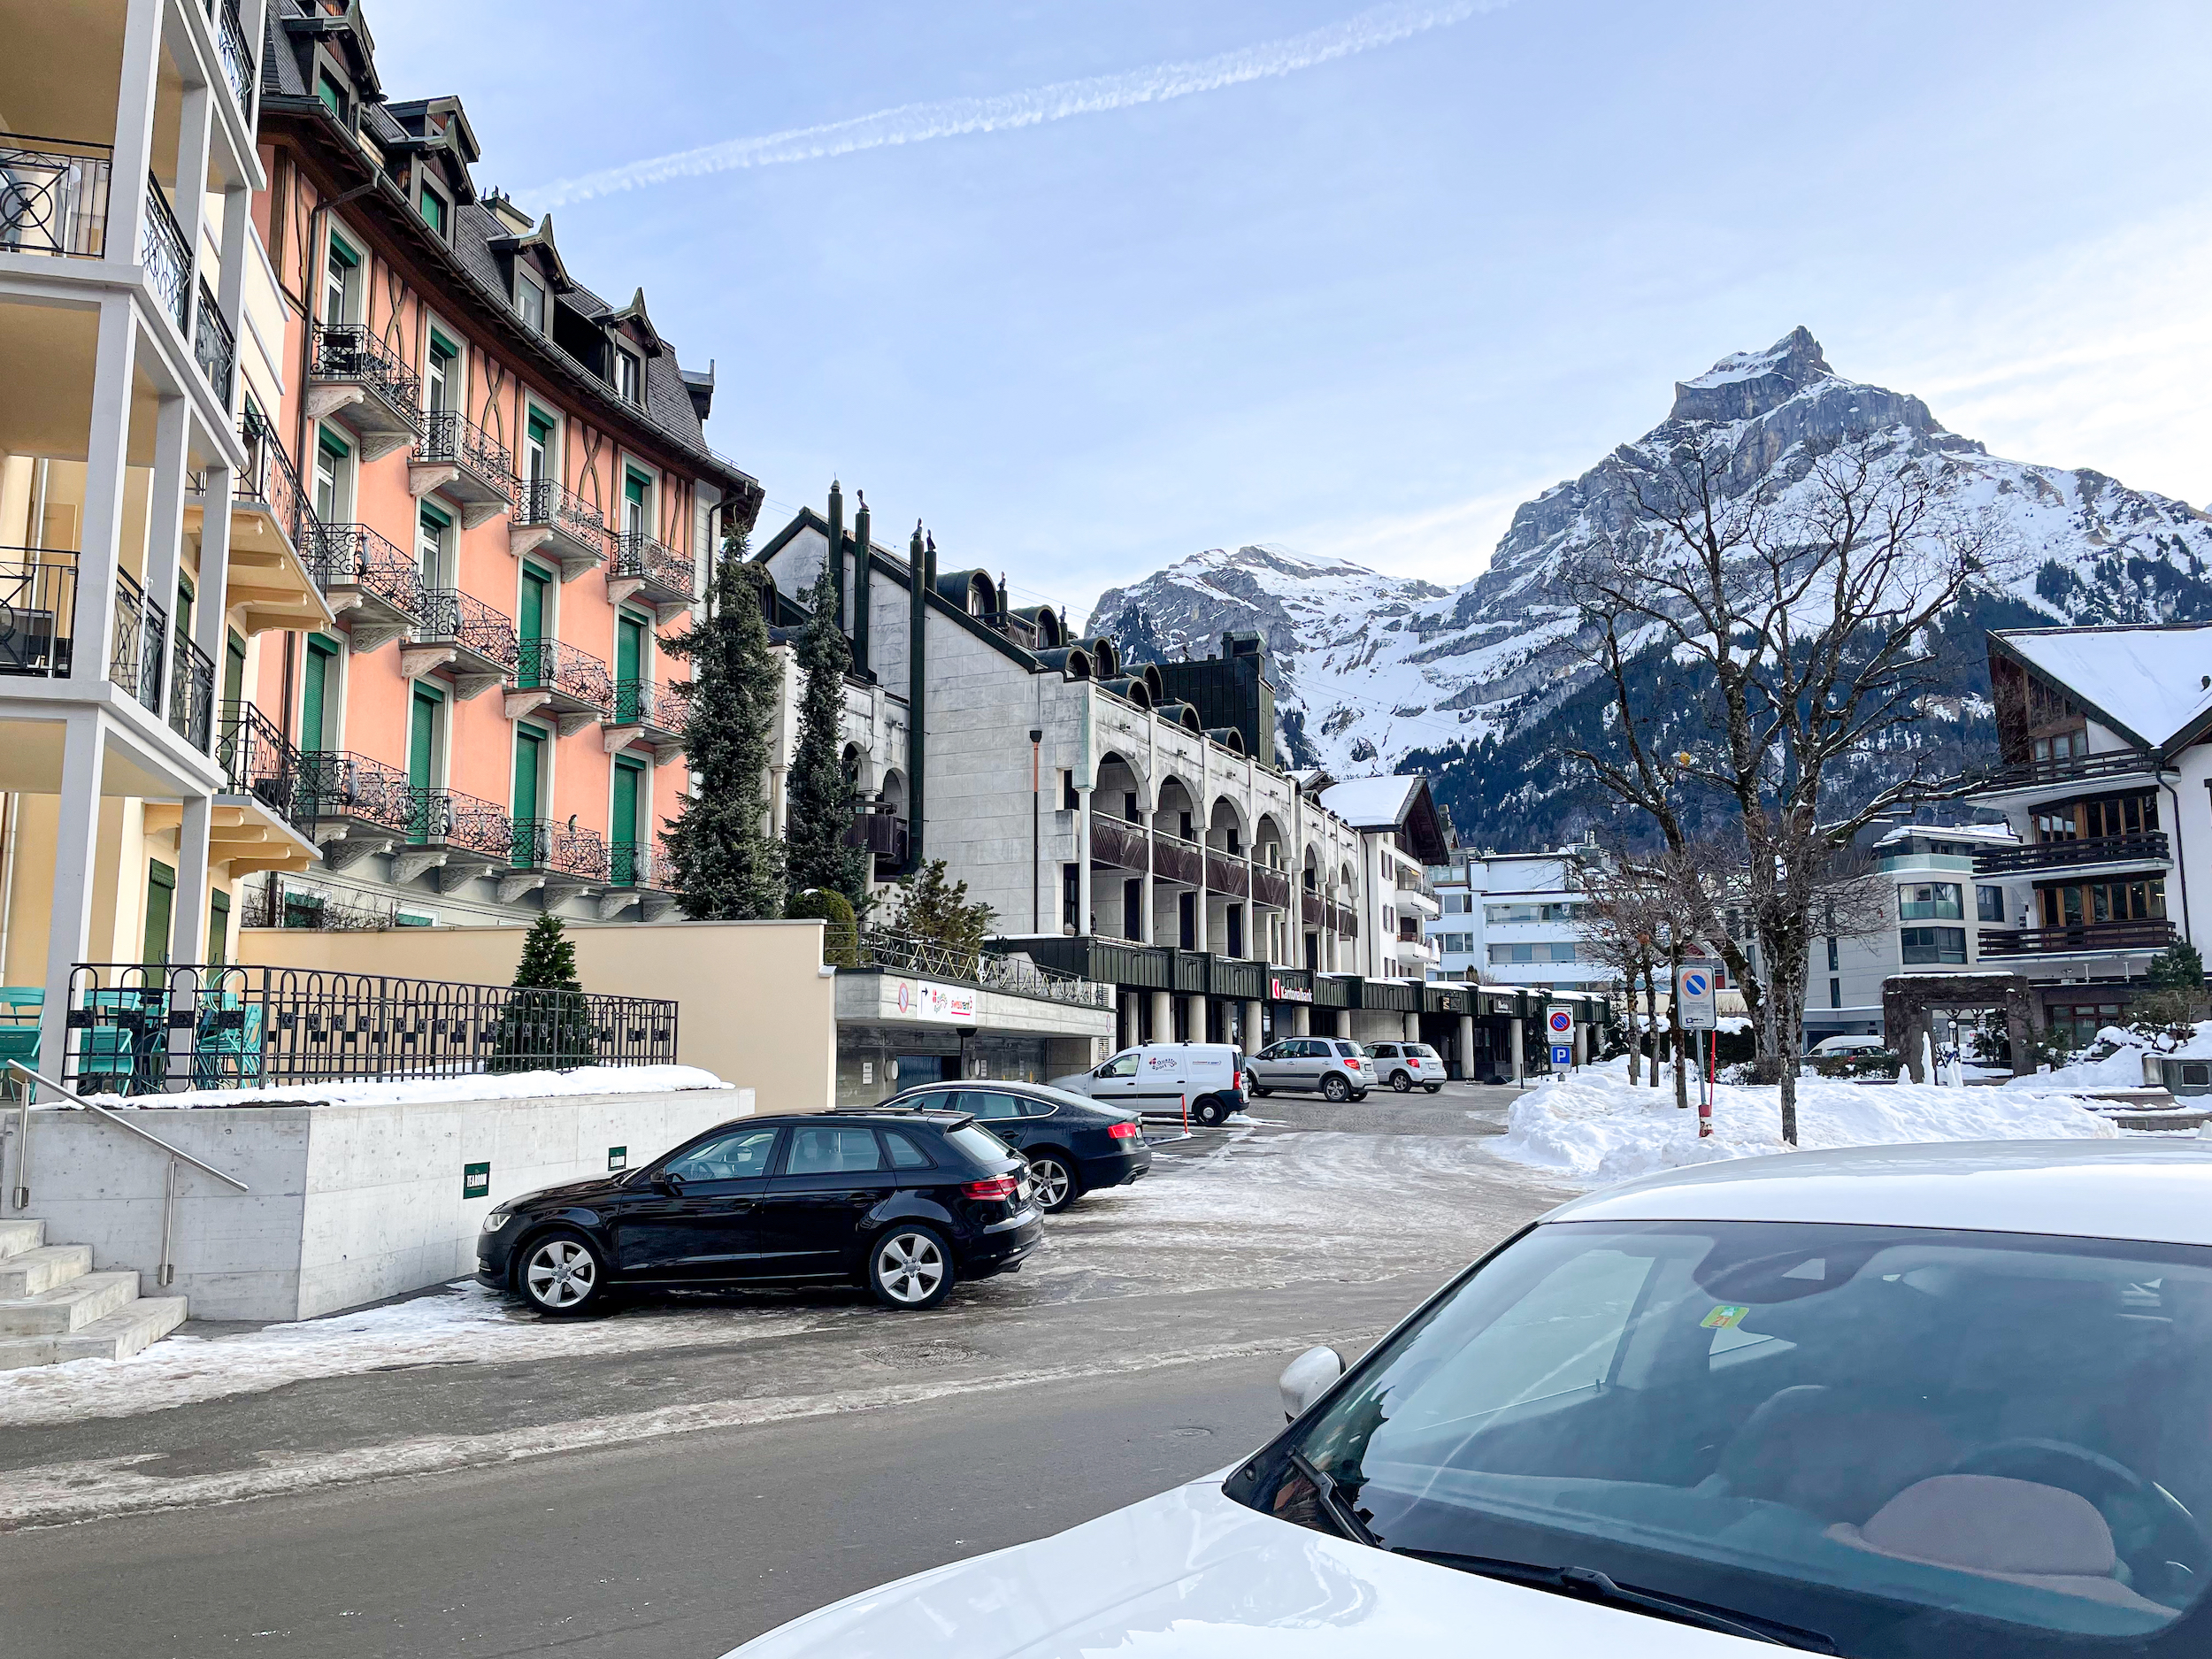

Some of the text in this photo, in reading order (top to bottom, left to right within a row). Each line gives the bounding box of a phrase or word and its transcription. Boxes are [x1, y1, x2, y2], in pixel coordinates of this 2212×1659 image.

[1280, 985, 1312, 1002] Kantonalbank
[1156, 1057, 1178, 1066] Quattro
[1557, 1048, 1567, 1062] P
[466, 1173, 487, 1187] TEAROOM
[1711, 1316, 1732, 1326] 21
